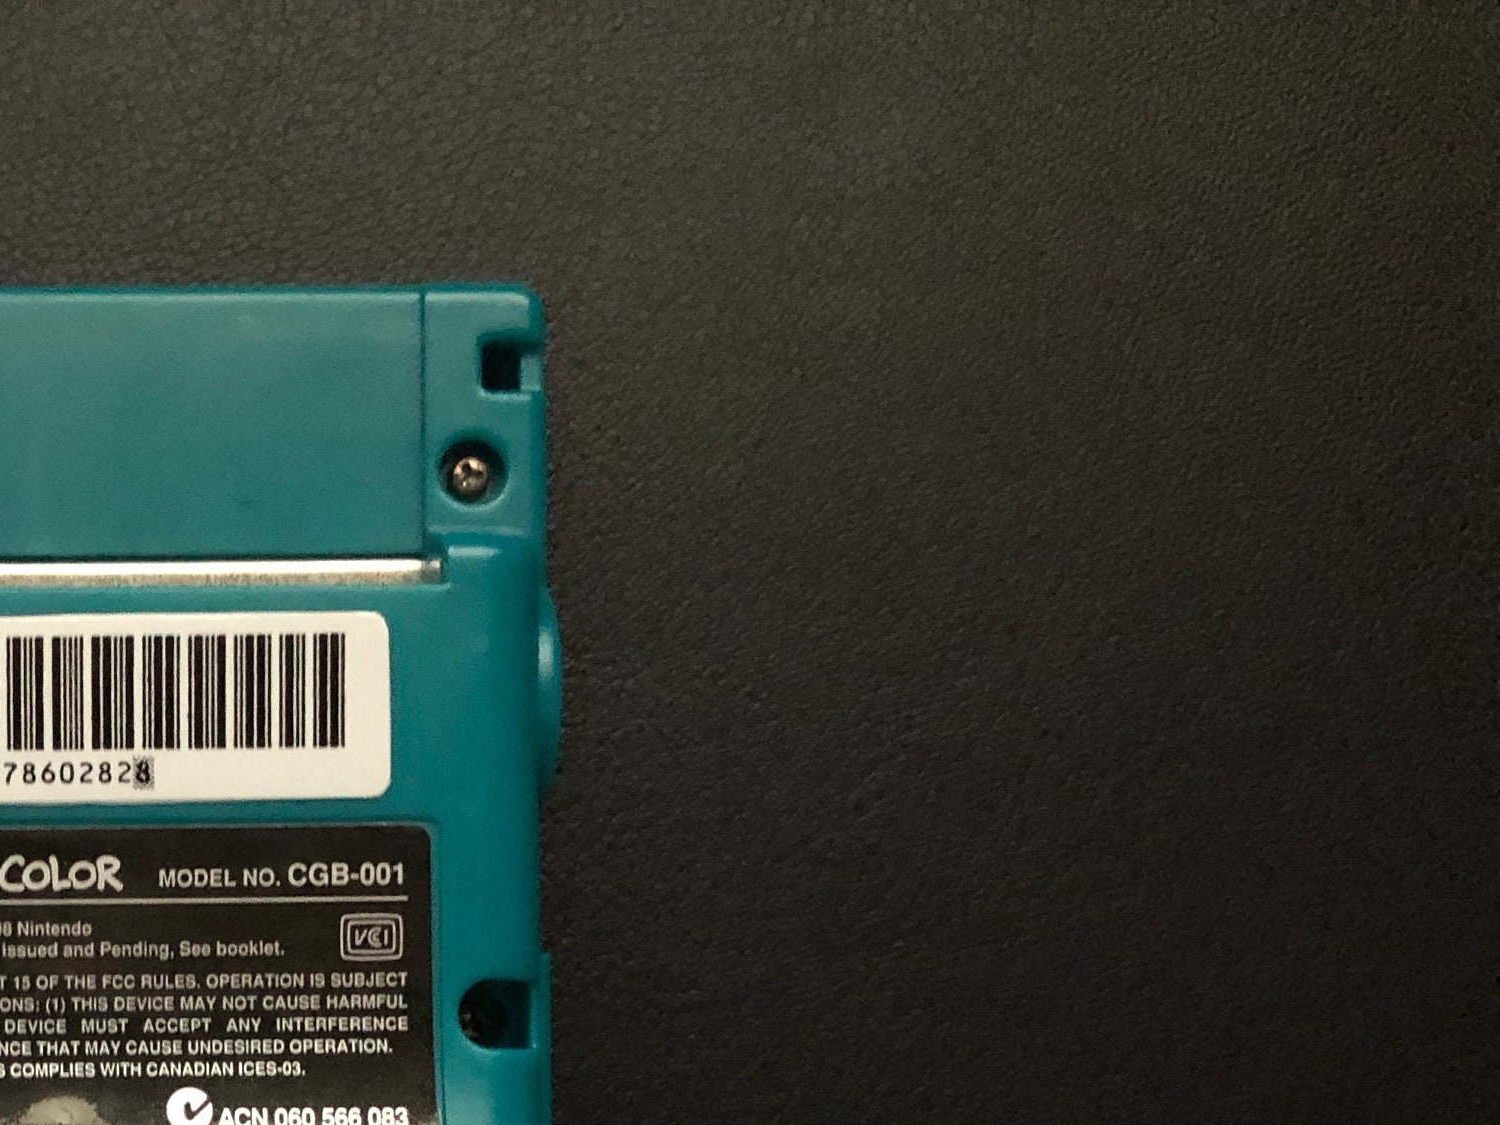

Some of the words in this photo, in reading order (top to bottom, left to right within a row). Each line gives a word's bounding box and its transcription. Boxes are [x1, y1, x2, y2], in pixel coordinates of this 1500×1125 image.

[158, 868, 237, 888] MODEL
[243, 867, 281, 887] NO.
[287, 862, 404, 886] CGB-001
[17, 921, 93, 937] Nintendo
[63, 941, 95, 958] and
[100, 941, 175, 961] Pending,
[179, 940, 211, 956] See
[216, 939, 286, 956] booklet.
[13, 975, 31, 991] 15
[36, 975, 59, 991] OF
[65, 974, 97, 990] THE
[102, 974, 136, 990] FCC
[141, 974, 201, 990] RULES.
[206, 972, 305, 988] OPERATION
[310, 972, 326, 988] IS
[330, 972, 408, 988] SUBJECT
[45, 996, 66, 1012] (1)
[72, 996, 108, 1012] THIS
[114, 996, 175, 1012] DEVICE
[180, 995, 216, 1011] MAY
[222, 995, 257, 1011] NOT
[263, 995, 321, 1011] CAUSE
[326, 995, 408, 1011] HARMFUL
[5, 1019, 66, 1035] DEVICE
[81, 1019, 129, 1035] MUST
[143, 1017, 212, 1034] ACCEPT
[226, 1017, 262, 1034] ANY
[276, 1017, 409, 1034] INTERFERENCE
[38, 1041, 80, 1057] THAT
[85, 1040, 120, 1056] MAY
[125, 1040, 182, 1056] CAUSE
[187, 1040, 285, 1056] UNDESIRED
[289, 1040, 394, 1056] OPERATION.
[10, 1062, 95, 1078] COMPLIES
[101, 1062, 143, 1078] WITH
[146, 1062, 234, 1078] CANADIAN
[239, 1062, 306, 1078] ICES-03.
